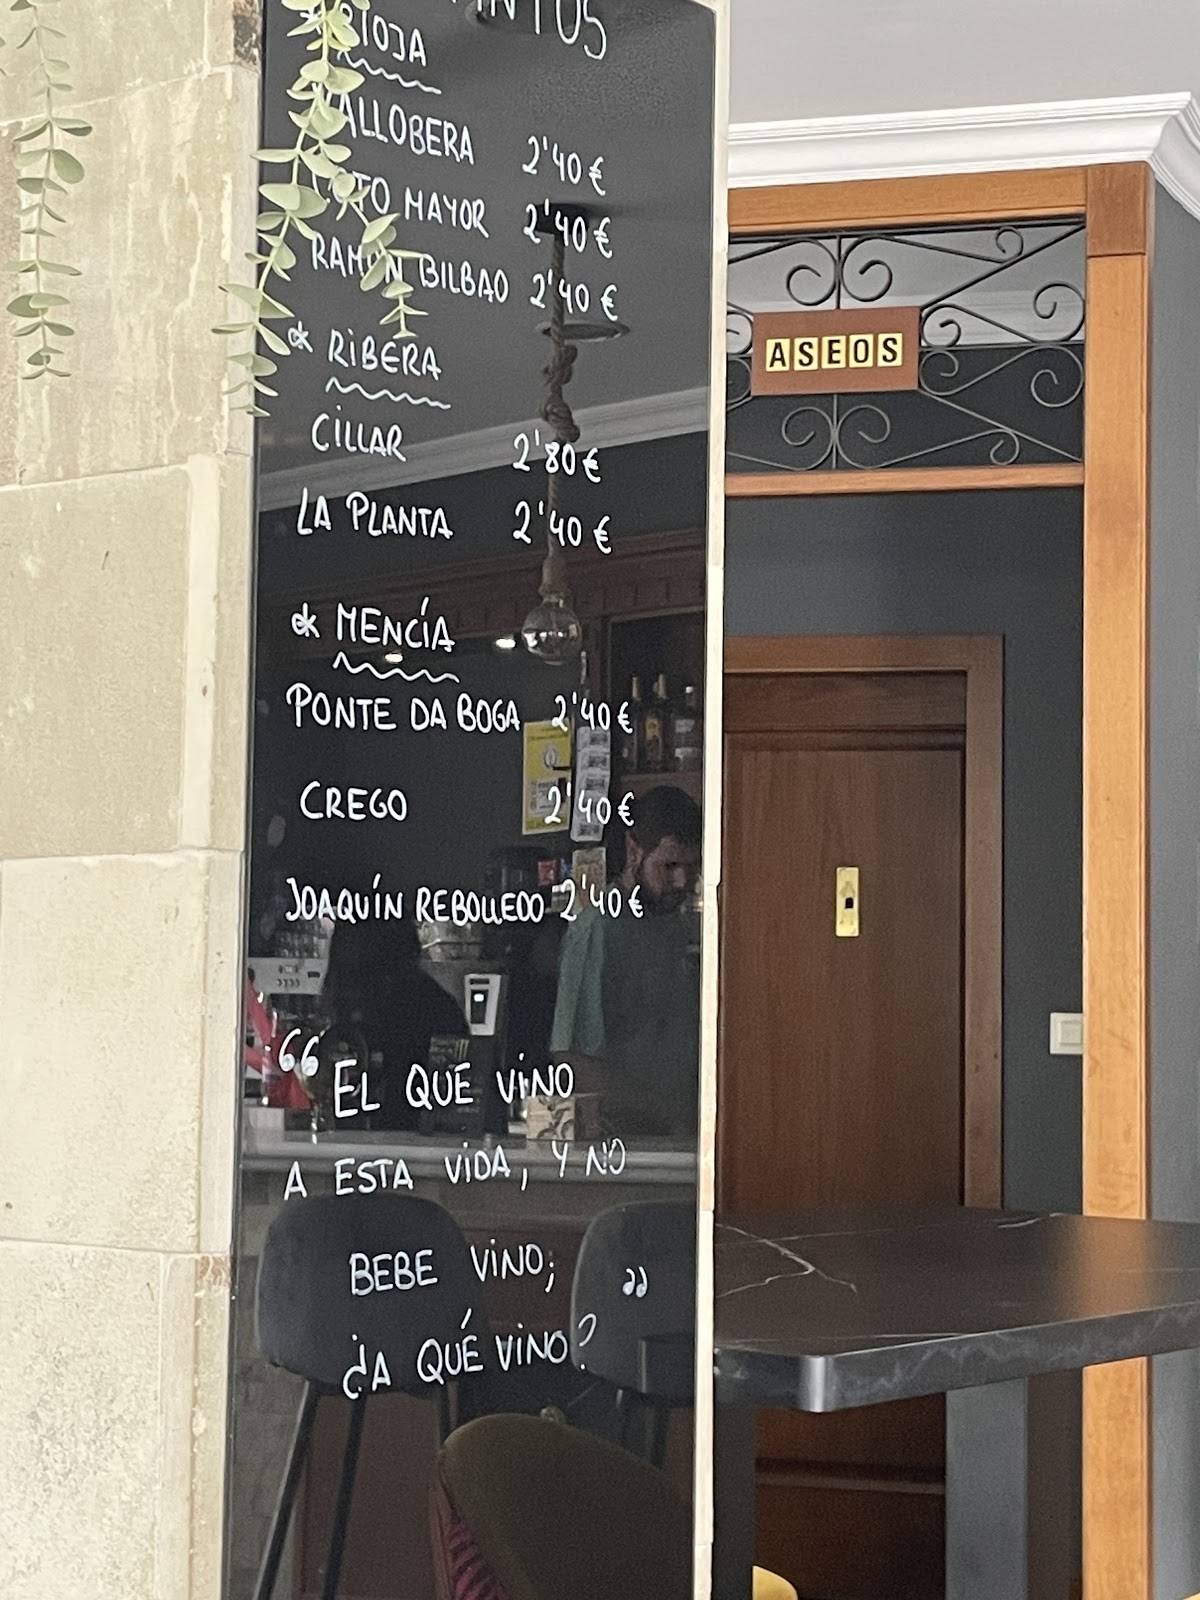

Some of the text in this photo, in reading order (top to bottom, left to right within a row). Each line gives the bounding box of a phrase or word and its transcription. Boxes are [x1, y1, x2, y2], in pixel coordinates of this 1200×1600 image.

[404, 186, 490, 239] MAYOR
[418, 253, 509, 303] BILBAO
[769, 337, 898, 368] ASEOS
[297, 487, 332, 535] LA
[345, 491, 454, 540] PLANTA
[337, 596, 456, 653] MENCÍA
[286, 682, 397, 731] PONTE
[410, 697, 447, 731] DA
[456, 693, 521, 734] BOGA
[300, 780, 407, 821] CREGO
[285, 873, 403, 923] JOAQUÍN
[334, 1059, 381, 1118] EL
[283, 1160, 308, 1201] A
[334, 1157, 414, 1196] ESTA
[551, 1140, 569, 1178] Y
[585, 1137, 626, 1177] NO
[349, 1249, 438, 1296] BEBE
[416, 1308, 484, 1385] QUÉ
